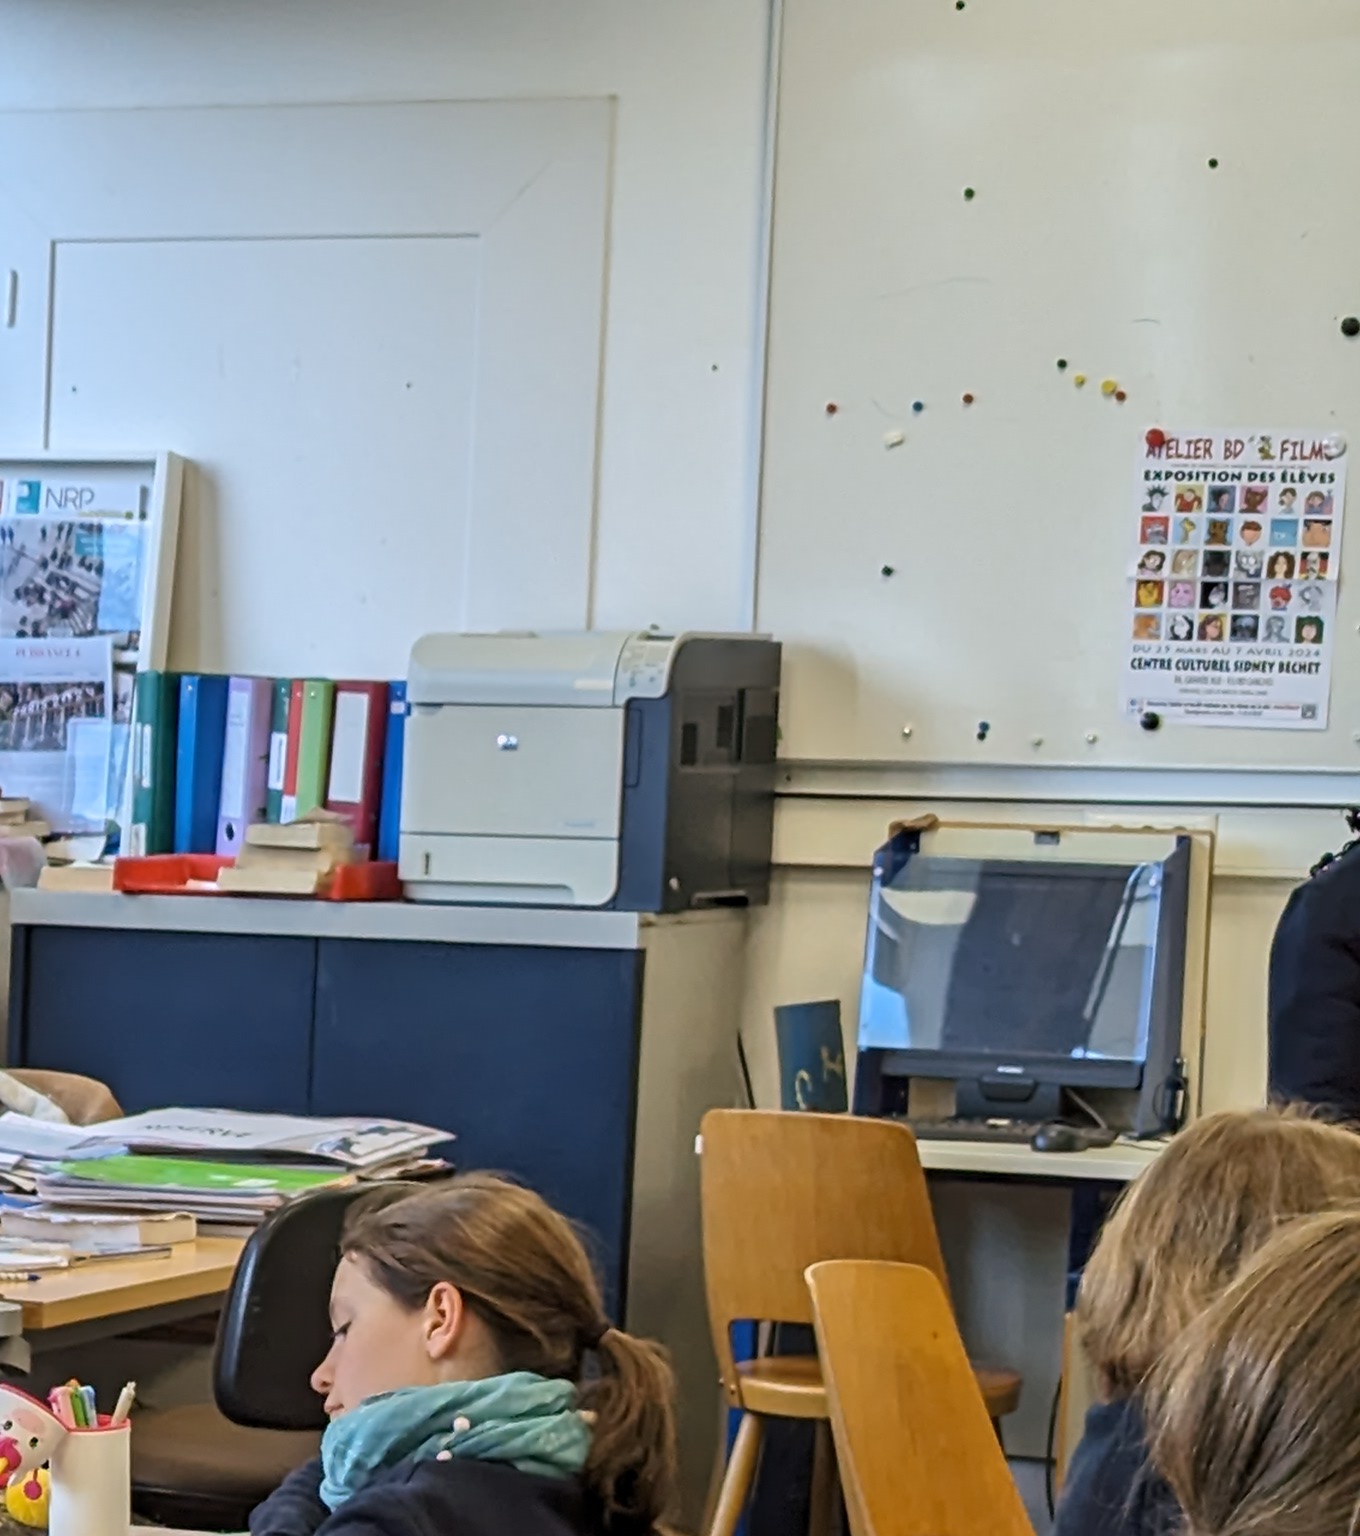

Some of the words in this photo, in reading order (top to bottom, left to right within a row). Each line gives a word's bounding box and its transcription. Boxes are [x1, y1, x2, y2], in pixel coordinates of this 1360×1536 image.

[1223, 438, 1245, 460] BD
[1143, 469, 1243, 483] EXPOSITION
[1247, 471, 1276, 483] DES
[1280, 468, 1336, 484] ÉLÈVES
[45, 486, 95, 509] NRP
[1130, 657, 1173, 671] CENTRE
[1174, 658, 1231, 673] CULTUREL
[1233, 659, 1276, 674] SIDNEY
[1278, 660, 1322, 675] BECHET
